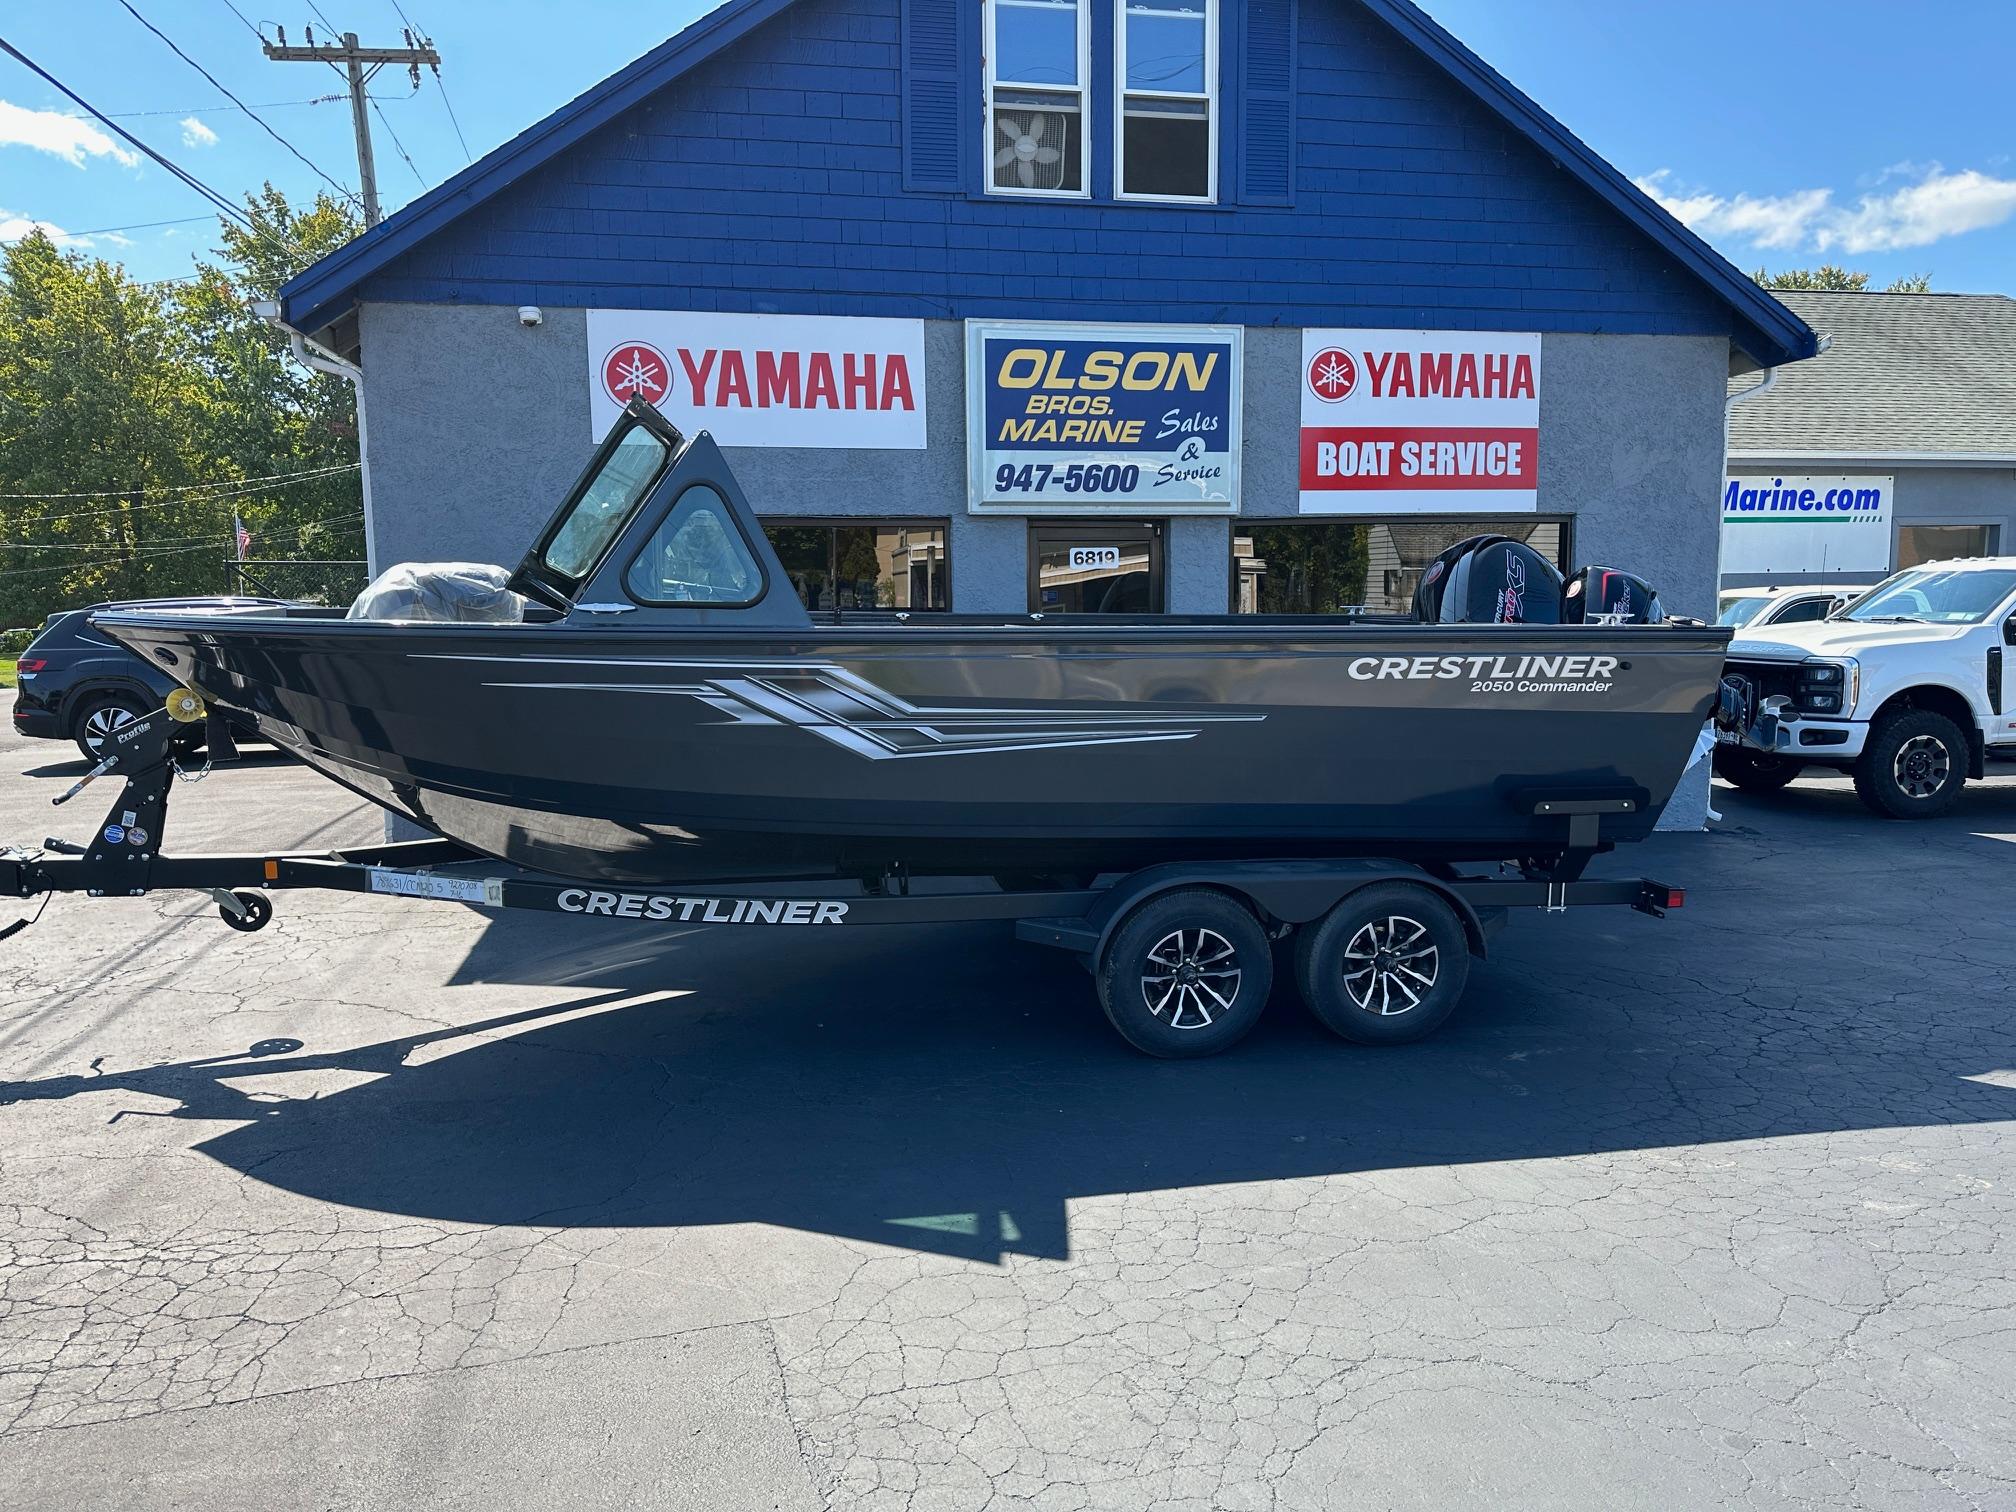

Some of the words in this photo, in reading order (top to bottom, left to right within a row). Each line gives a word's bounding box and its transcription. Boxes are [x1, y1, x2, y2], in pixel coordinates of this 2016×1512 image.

[677, 348, 916, 412] YAMAHA
[997, 348, 1219, 392] OLSON
[1363, 351, 1536, 399] YAMAHA
[1025, 395, 1115, 415] BROS.
[998, 419, 1146, 443] MARINE
[1155, 408, 1219, 439] Sales
[1181, 442, 1200, 462] &
[1317, 441, 1395, 477] BOAT
[1400, 441, 1522, 477] SERVICE
[995, 463, 1140, 493] 947-5600
[1153, 463, 1221, 487] Service
[1073, 550, 1116, 566] 6819
[1494, 588, 1505, 624] ERCURY
[1503, 588, 1517, 624] RO
[1348, 655, 1618, 680] CRESTLINER
[1470, 680, 1514, 692] 2050
[1517, 680, 1614, 692] Commander
[117, 722, 150, 742] Profile
[557, 888, 850, 924] CRESTLINER
